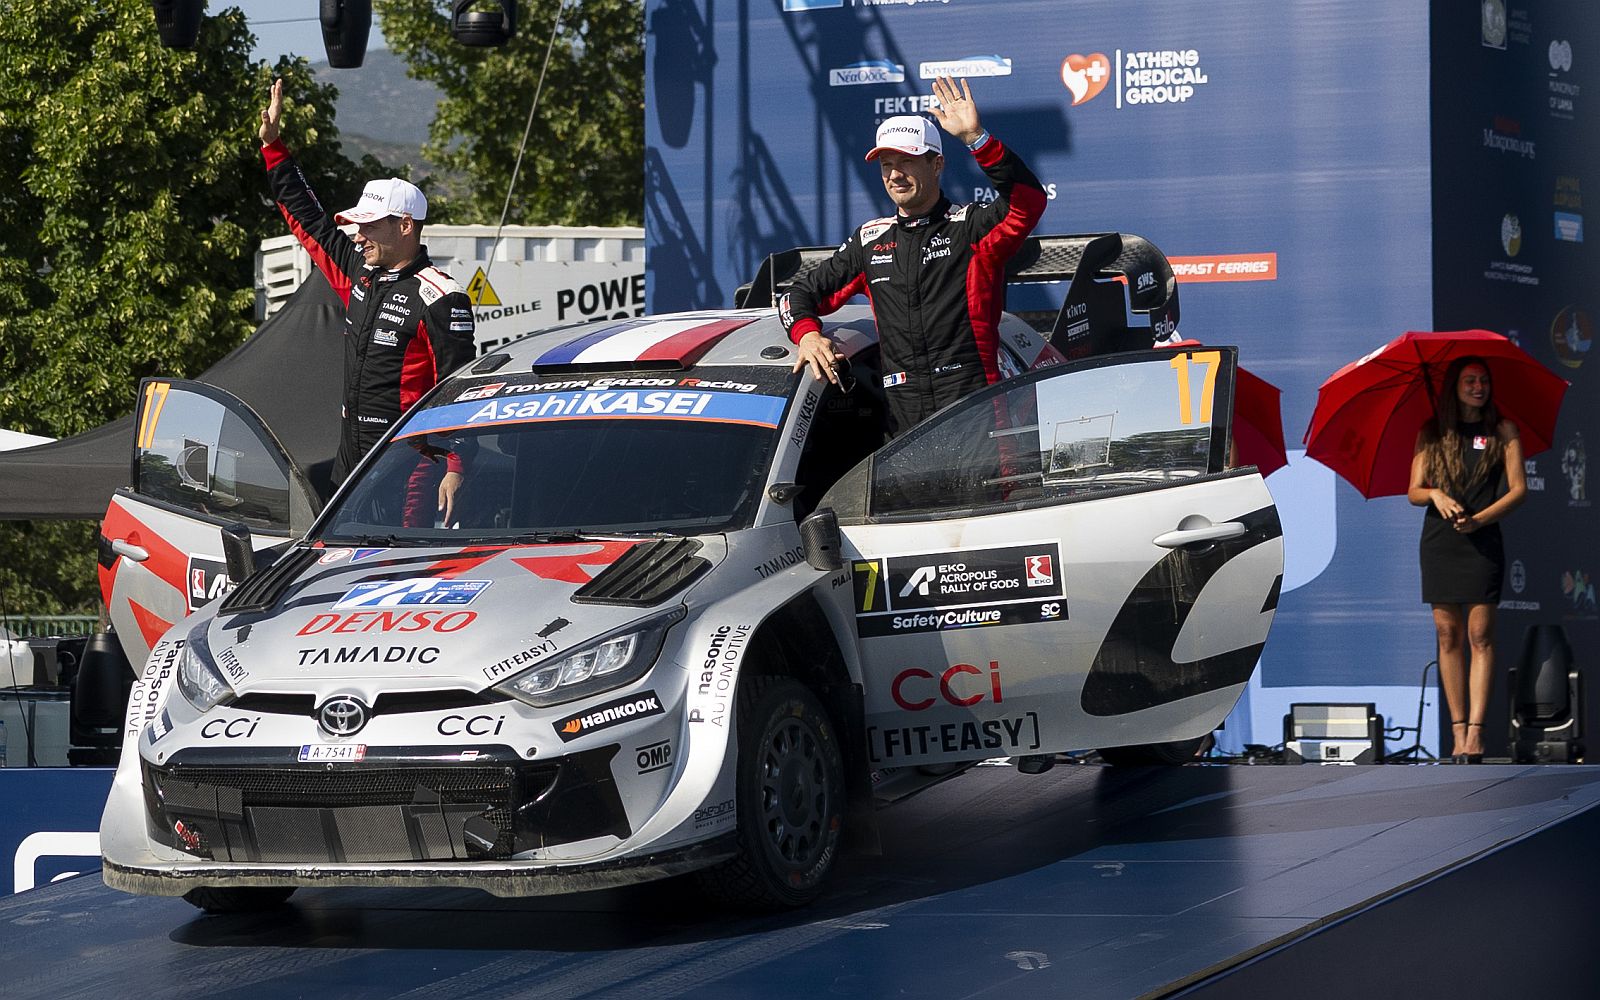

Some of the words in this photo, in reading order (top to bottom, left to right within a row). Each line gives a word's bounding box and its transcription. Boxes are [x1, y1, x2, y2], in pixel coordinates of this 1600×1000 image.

[1125, 50, 1200, 69] ATHENS
[1125, 68, 1208, 87] MEDICAL
[1125, 86, 1194, 105] GROUP
[1216, 261, 1269, 274] FERRIES
[1137, 272, 1155, 290] SWS
[382, 302, 411, 316] TAMADIC
[476, 300, 542, 323] MOBILE
[1154, 314, 1175, 338] Stilo
[504, 380, 590, 394] TOYOTA
[585, 377, 676, 391] GAZOO
[677, 377, 758, 392] Racing
[1170, 350, 1221, 425] 17
[137, 381, 171, 449] 17
[754, 546, 805, 578] TAMADIC
[939, 563, 966, 578] EKO
[939, 570, 998, 584] ACROPOLIS
[941, 582, 972, 594] RALLY
[973, 580, 988, 591] OF
[990, 578, 1020, 590] GODS
[420, 591, 450, 604] 17
[1041, 602, 1061, 616] SC
[295, 611, 478, 635] DENSO
[893, 610, 1002, 629] SafetyCulture
[298, 646, 441, 666] TAMADIC
[688, 625, 731, 723] Pnasonic
[711, 624, 752, 727] AUTOMOTIVE
[312, 746, 353, 759] A-7541
[636, 744, 671, 769] OMP
